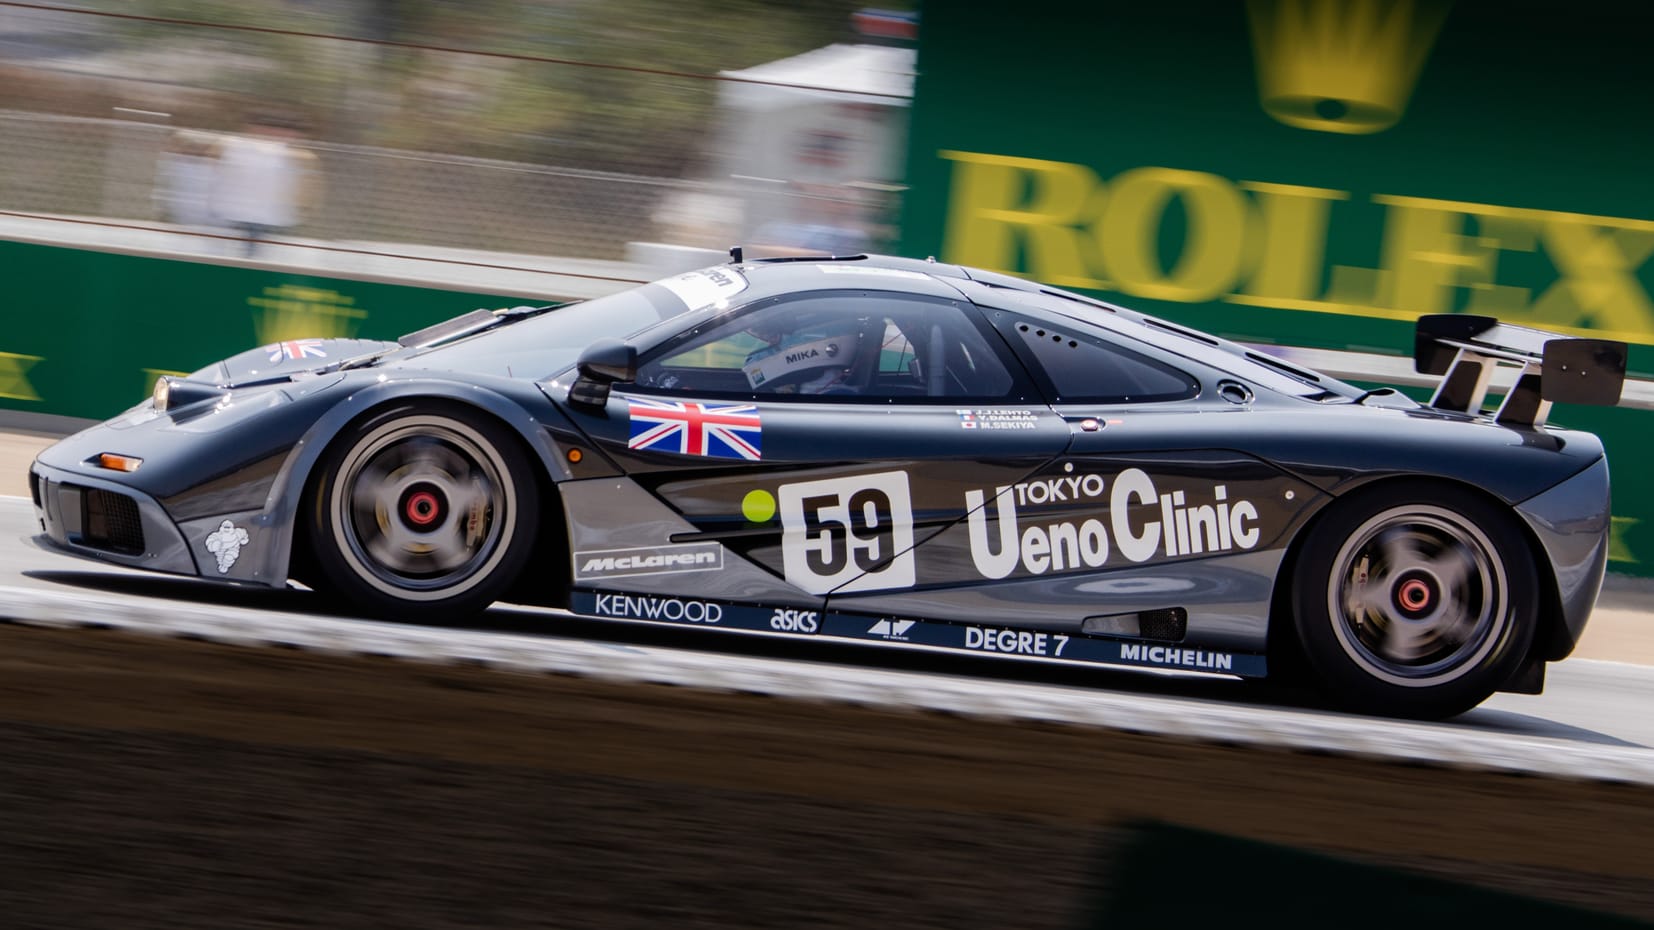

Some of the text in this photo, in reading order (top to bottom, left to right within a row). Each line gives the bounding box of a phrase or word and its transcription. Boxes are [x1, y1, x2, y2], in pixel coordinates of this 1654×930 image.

[937, 148, 1654, 346] ROLEX
[786, 349, 819, 364] MIKA
[1015, 474, 1104, 506] TOKYO
[801, 488, 895, 577] 59
[965, 468, 1260, 580] Ueno Clinic
[581, 552, 716, 572] McLaren
[595, 594, 722, 623] KENWOOD
[770, 609, 817, 633] asics
[965, 626, 1069, 657] DEGRE 7
[1120, 644, 1232, 670] MICHELIN
